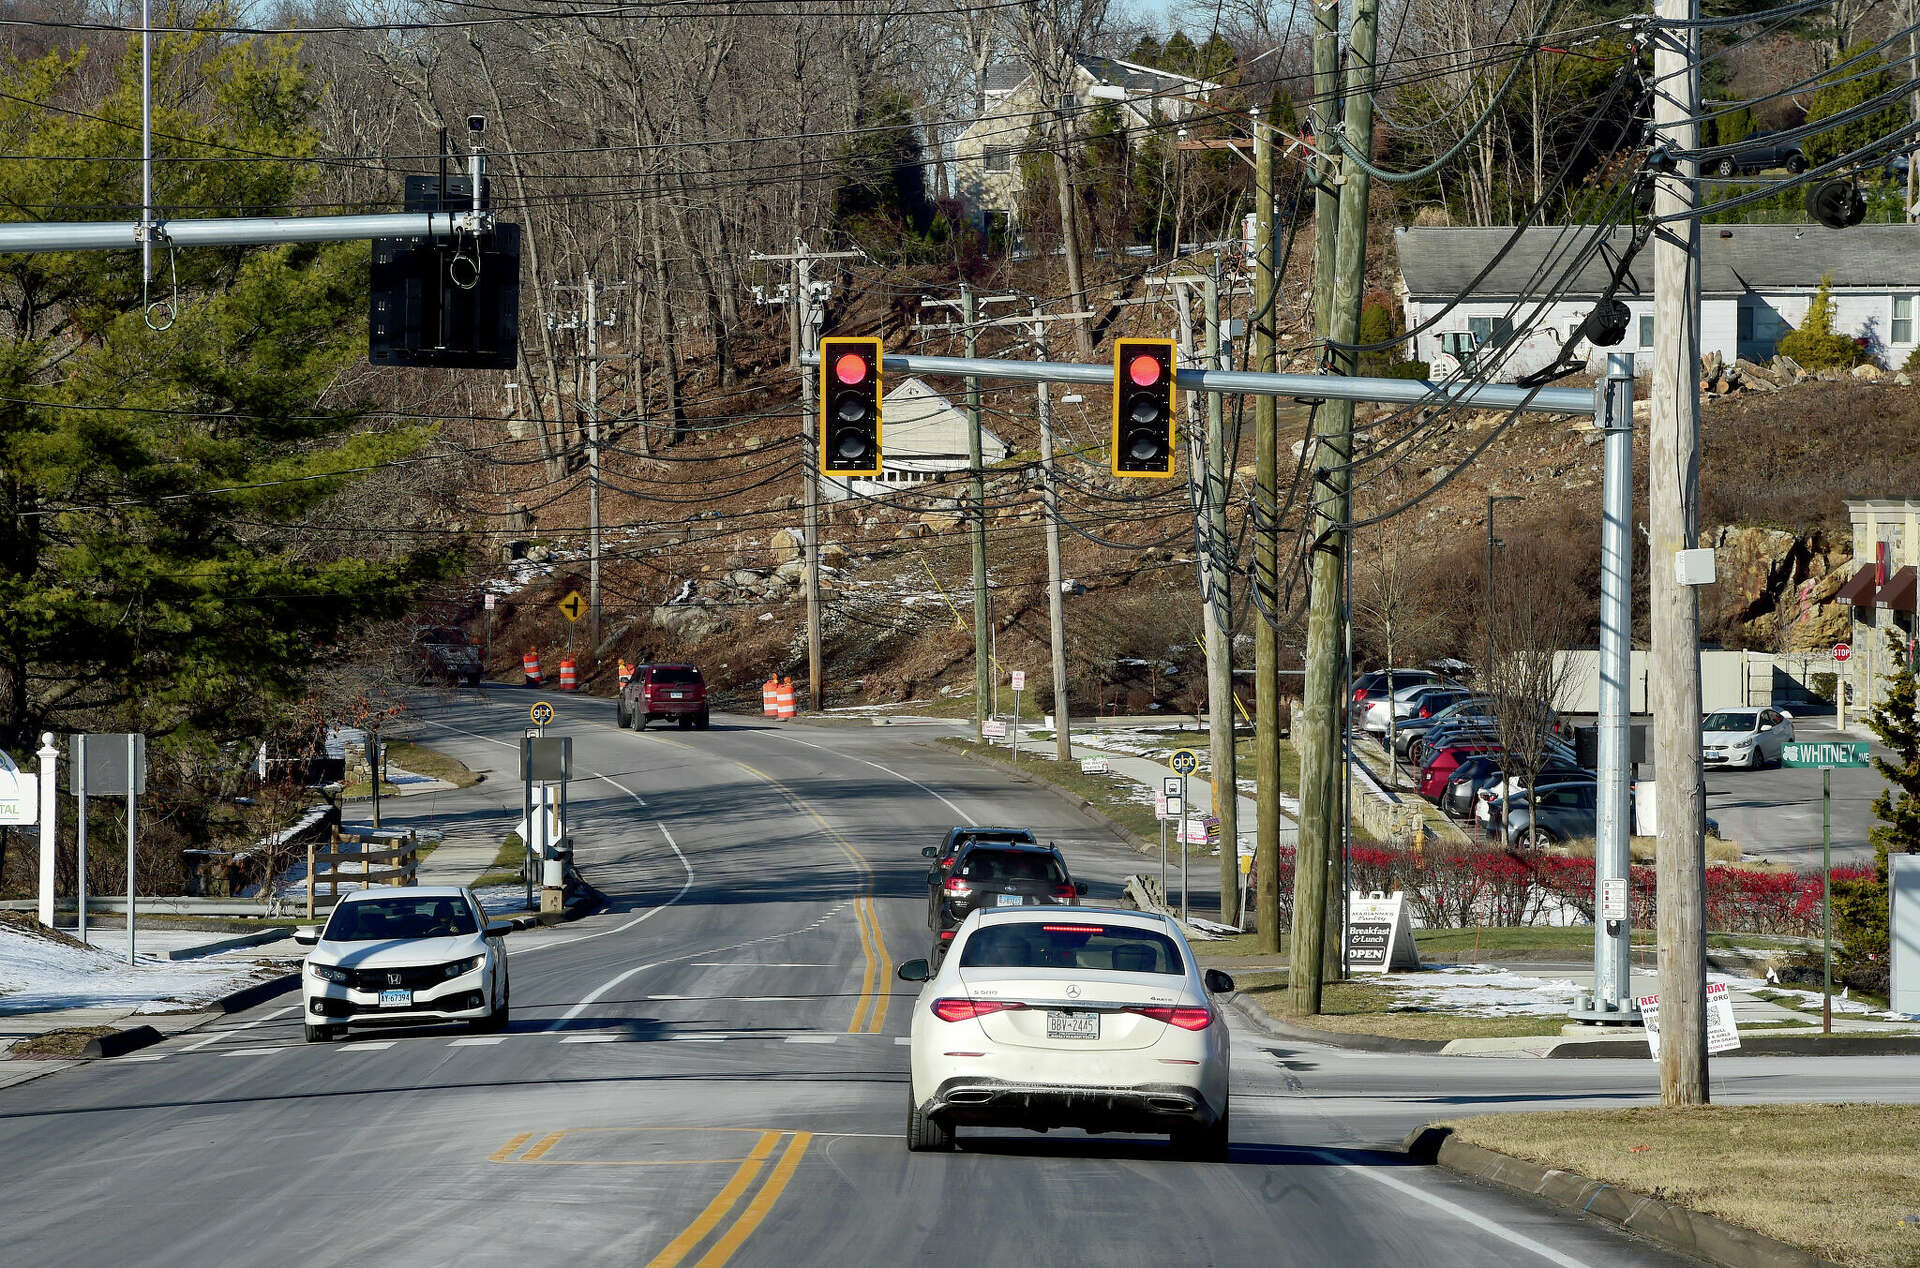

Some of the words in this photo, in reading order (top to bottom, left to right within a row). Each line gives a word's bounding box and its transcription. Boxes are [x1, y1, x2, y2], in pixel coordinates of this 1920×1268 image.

[533, 706, 551, 718] gbt
[1800, 744, 1855, 763] WHITNEY
[1857, 752, 1870, 762] AVE
[1173, 755, 1195, 769] gbt
[1350, 927, 1389, 935] Breakfast
[1350, 949, 1383, 959] OPEN
